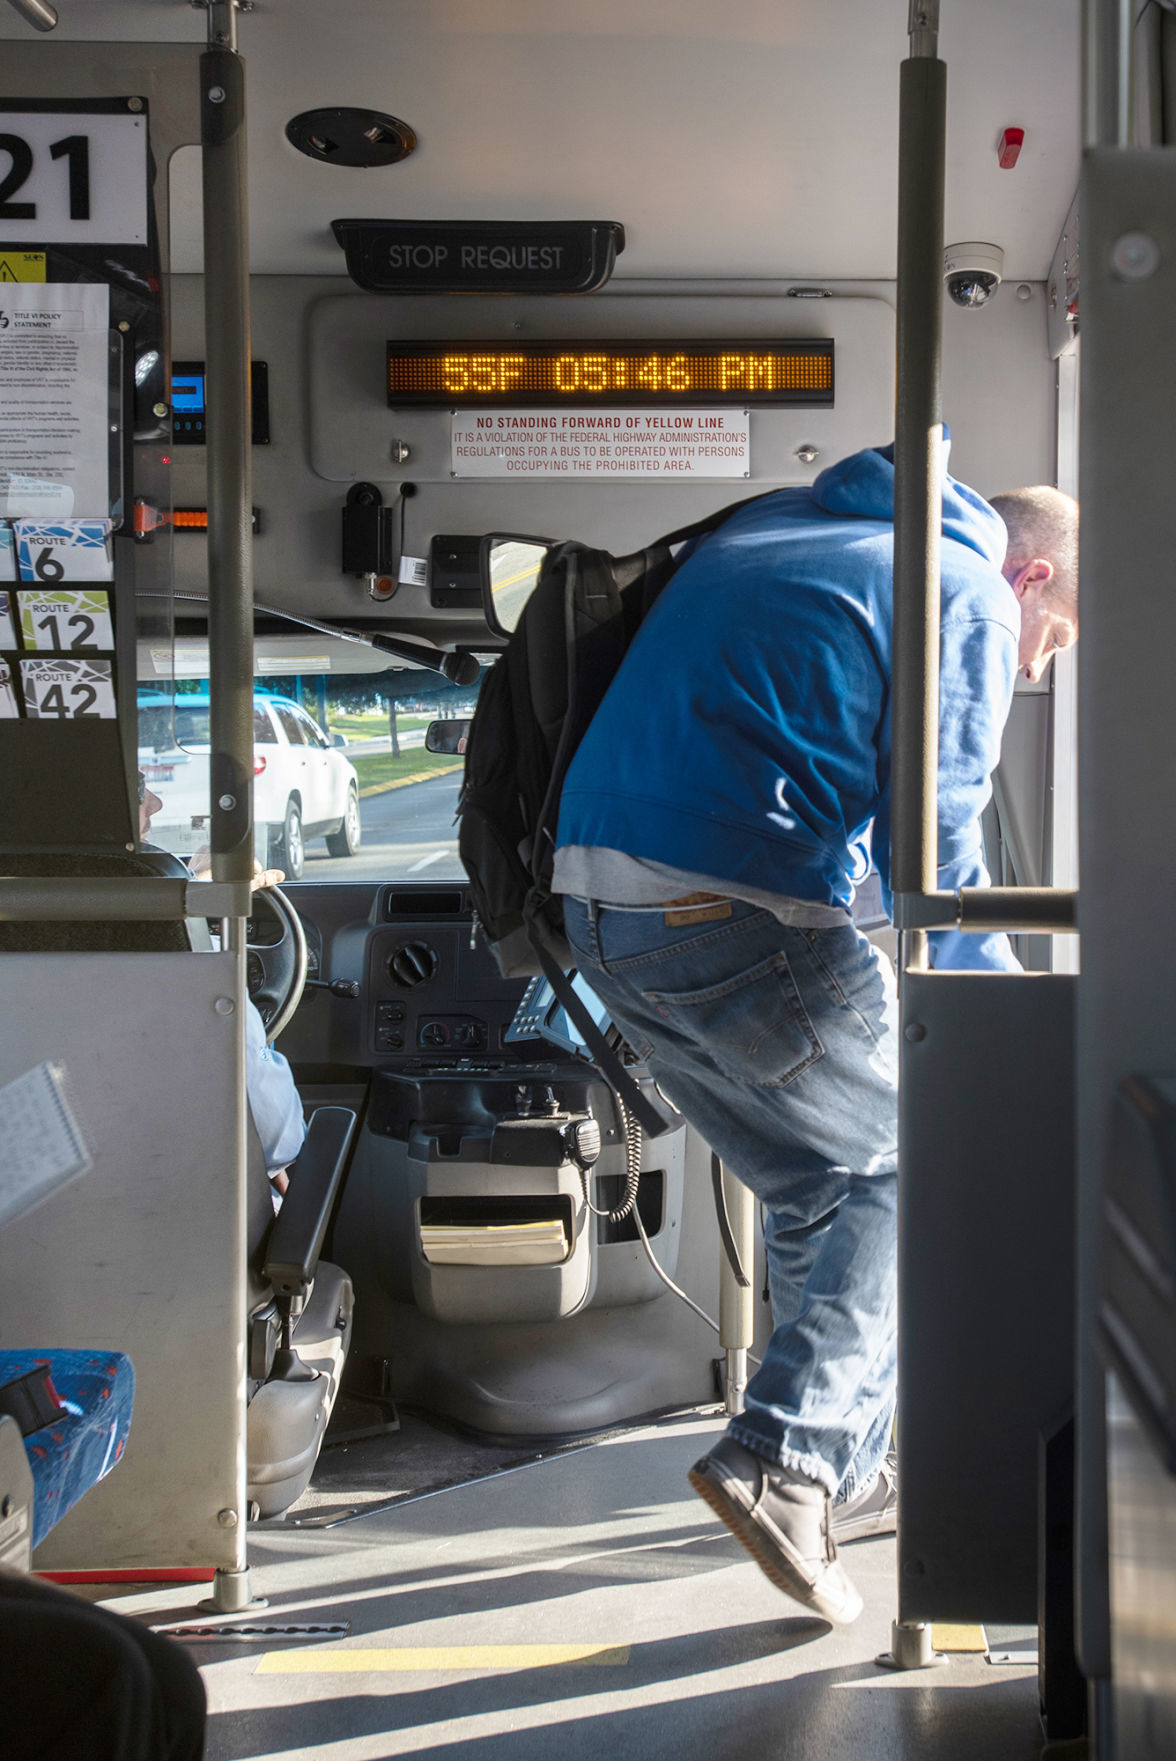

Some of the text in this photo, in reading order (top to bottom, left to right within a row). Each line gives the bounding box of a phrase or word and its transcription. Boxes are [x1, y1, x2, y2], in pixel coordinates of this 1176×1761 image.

[389, 245, 563, 269] STOP REQUEST
[445, 356, 773, 391] 55F 05:46 PM
[477, 417, 724, 428] NO STANDING FORWARD OF YELLOW LINE
[454, 432, 747, 443] IT IS A VIOLATION OF THE FEDERAL HIGHWAY ADMINISTRATION'S
[456, 446, 745, 457] REGULATIONS FOR A BUS TO BE OPERATED WITH PERSONS
[507, 460, 694, 471] OCCUPYING THE PROHIBITED AREA.
[29, 537, 66, 546] ROUTE
[35, 547, 64, 582] 6
[33, 604, 69, 613] ROUTE
[38, 614, 98, 650] 12
[36, 673, 72, 682] ROUTE
[40, 683, 100, 718] 42
